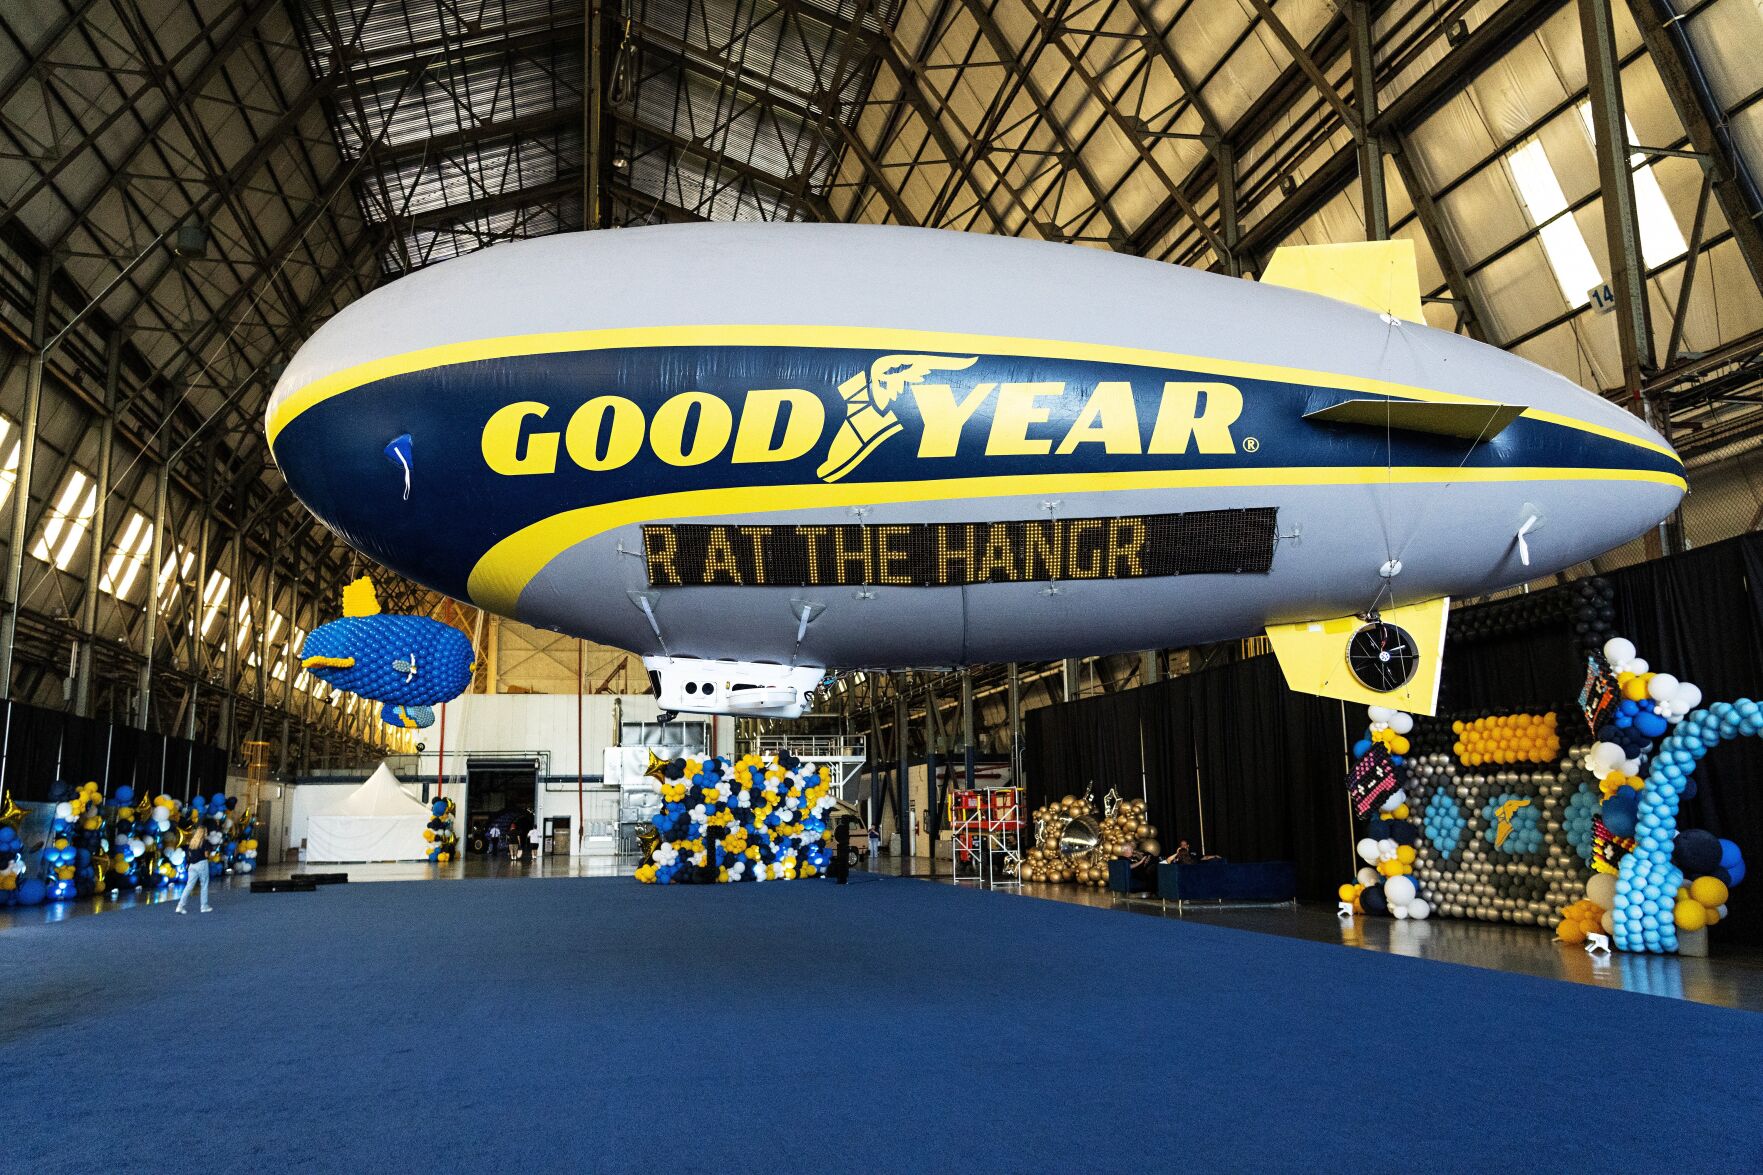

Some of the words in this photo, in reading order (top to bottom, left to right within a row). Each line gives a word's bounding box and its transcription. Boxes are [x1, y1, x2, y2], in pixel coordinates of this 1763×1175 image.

[1592, 284, 1614, 308] 14
[644, 526, 682, 583] R
[703, 526, 772, 583] AT
[796, 526, 912, 583] THE
[937, 517, 1146, 583] HANGR
